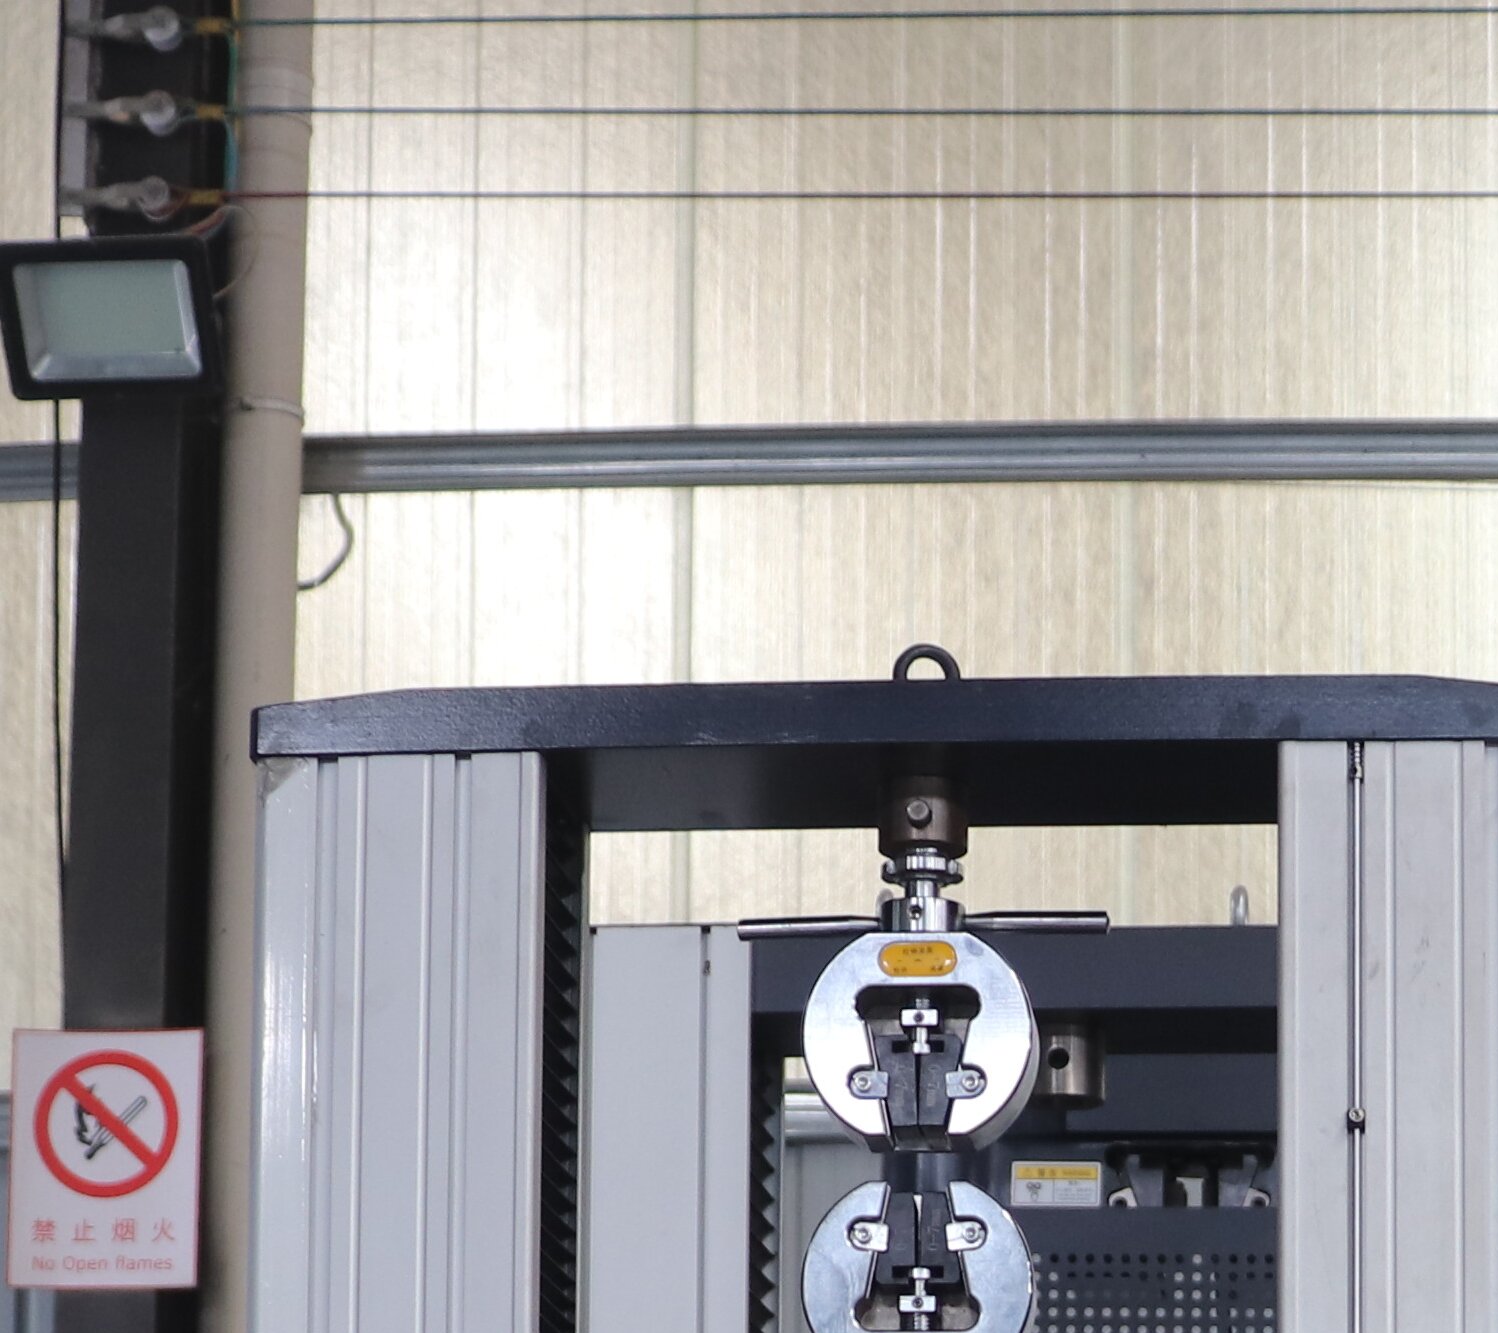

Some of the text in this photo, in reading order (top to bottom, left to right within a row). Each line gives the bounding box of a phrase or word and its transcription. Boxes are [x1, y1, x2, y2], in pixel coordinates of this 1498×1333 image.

[32, 1218, 174, 1243] 禁止烟火
[31, 1255, 173, 1273] No Open flames
